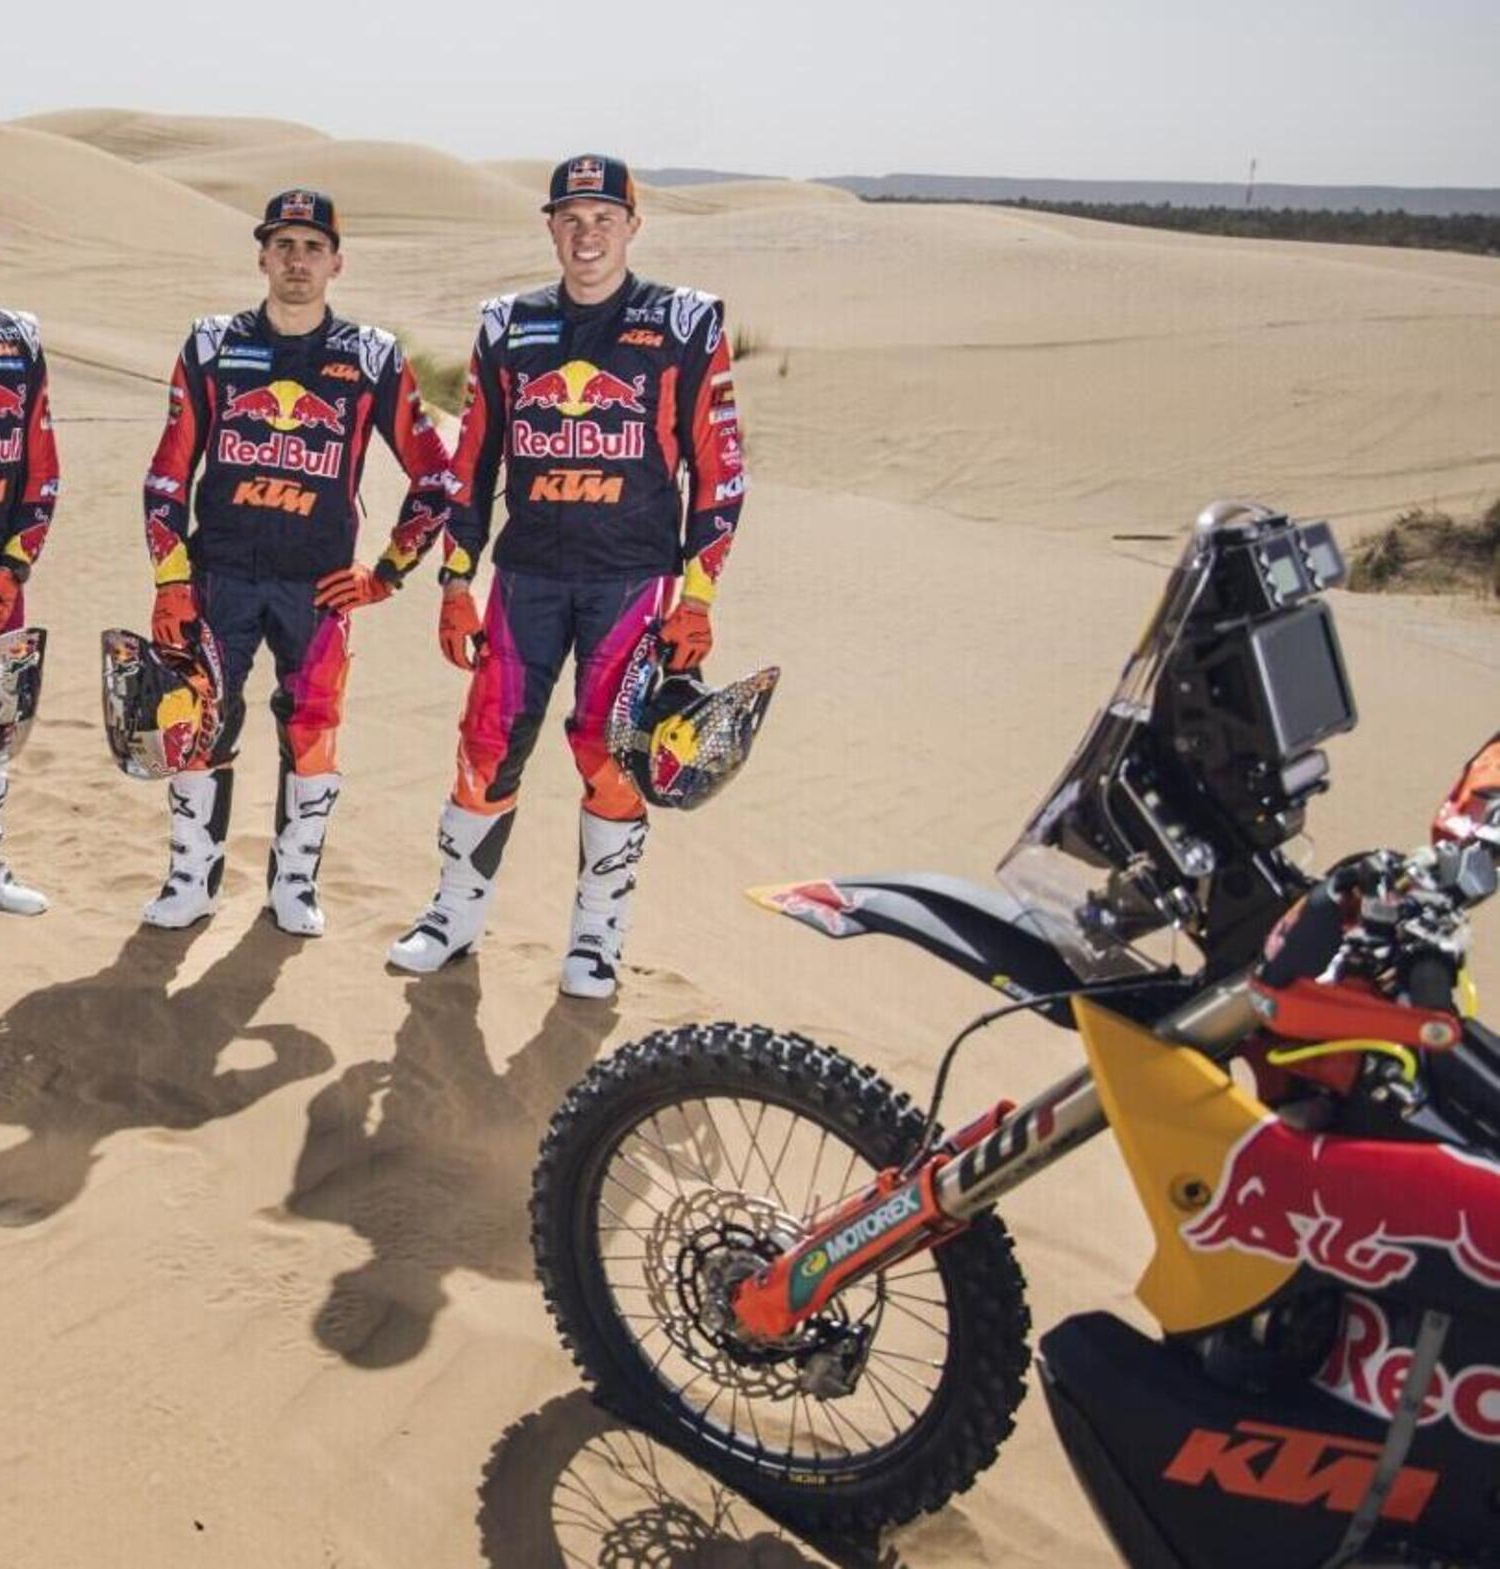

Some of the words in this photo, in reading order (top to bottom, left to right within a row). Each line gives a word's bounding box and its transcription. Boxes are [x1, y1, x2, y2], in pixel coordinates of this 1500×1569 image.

[218, 429, 283, 467] Red
[282, 435, 344, 478] Bull
[513, 419, 574, 458] Red
[575, 420, 645, 459] Bull
[232, 476, 318, 517] KTM
[529, 469, 624, 503] KTM
[825, 1185, 920, 1264] MOTOREX
[1162, 1419, 1439, 1523] KTM
